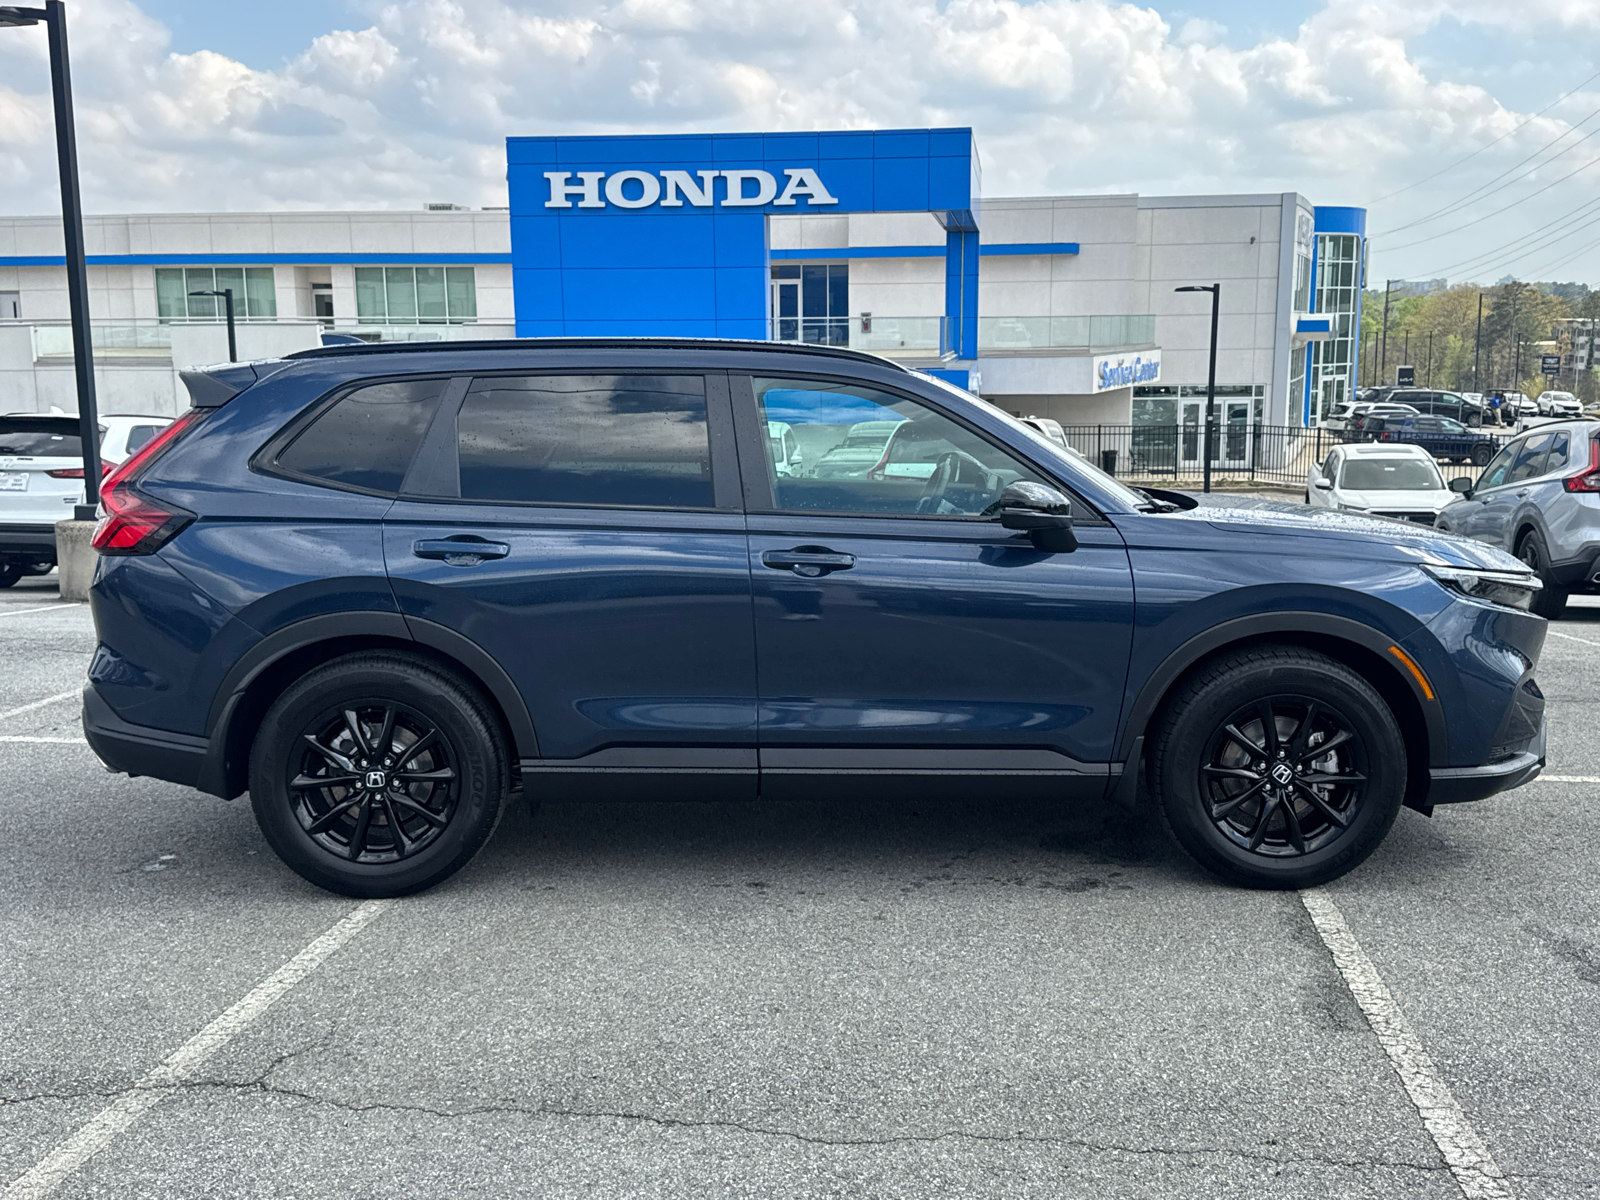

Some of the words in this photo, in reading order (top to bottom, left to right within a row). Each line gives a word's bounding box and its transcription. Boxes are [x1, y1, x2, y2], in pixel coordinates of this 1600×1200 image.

[543, 168, 839, 209] HONDA
[1099, 359, 1132, 388] Service
[1133, 356, 1160, 382] Center
